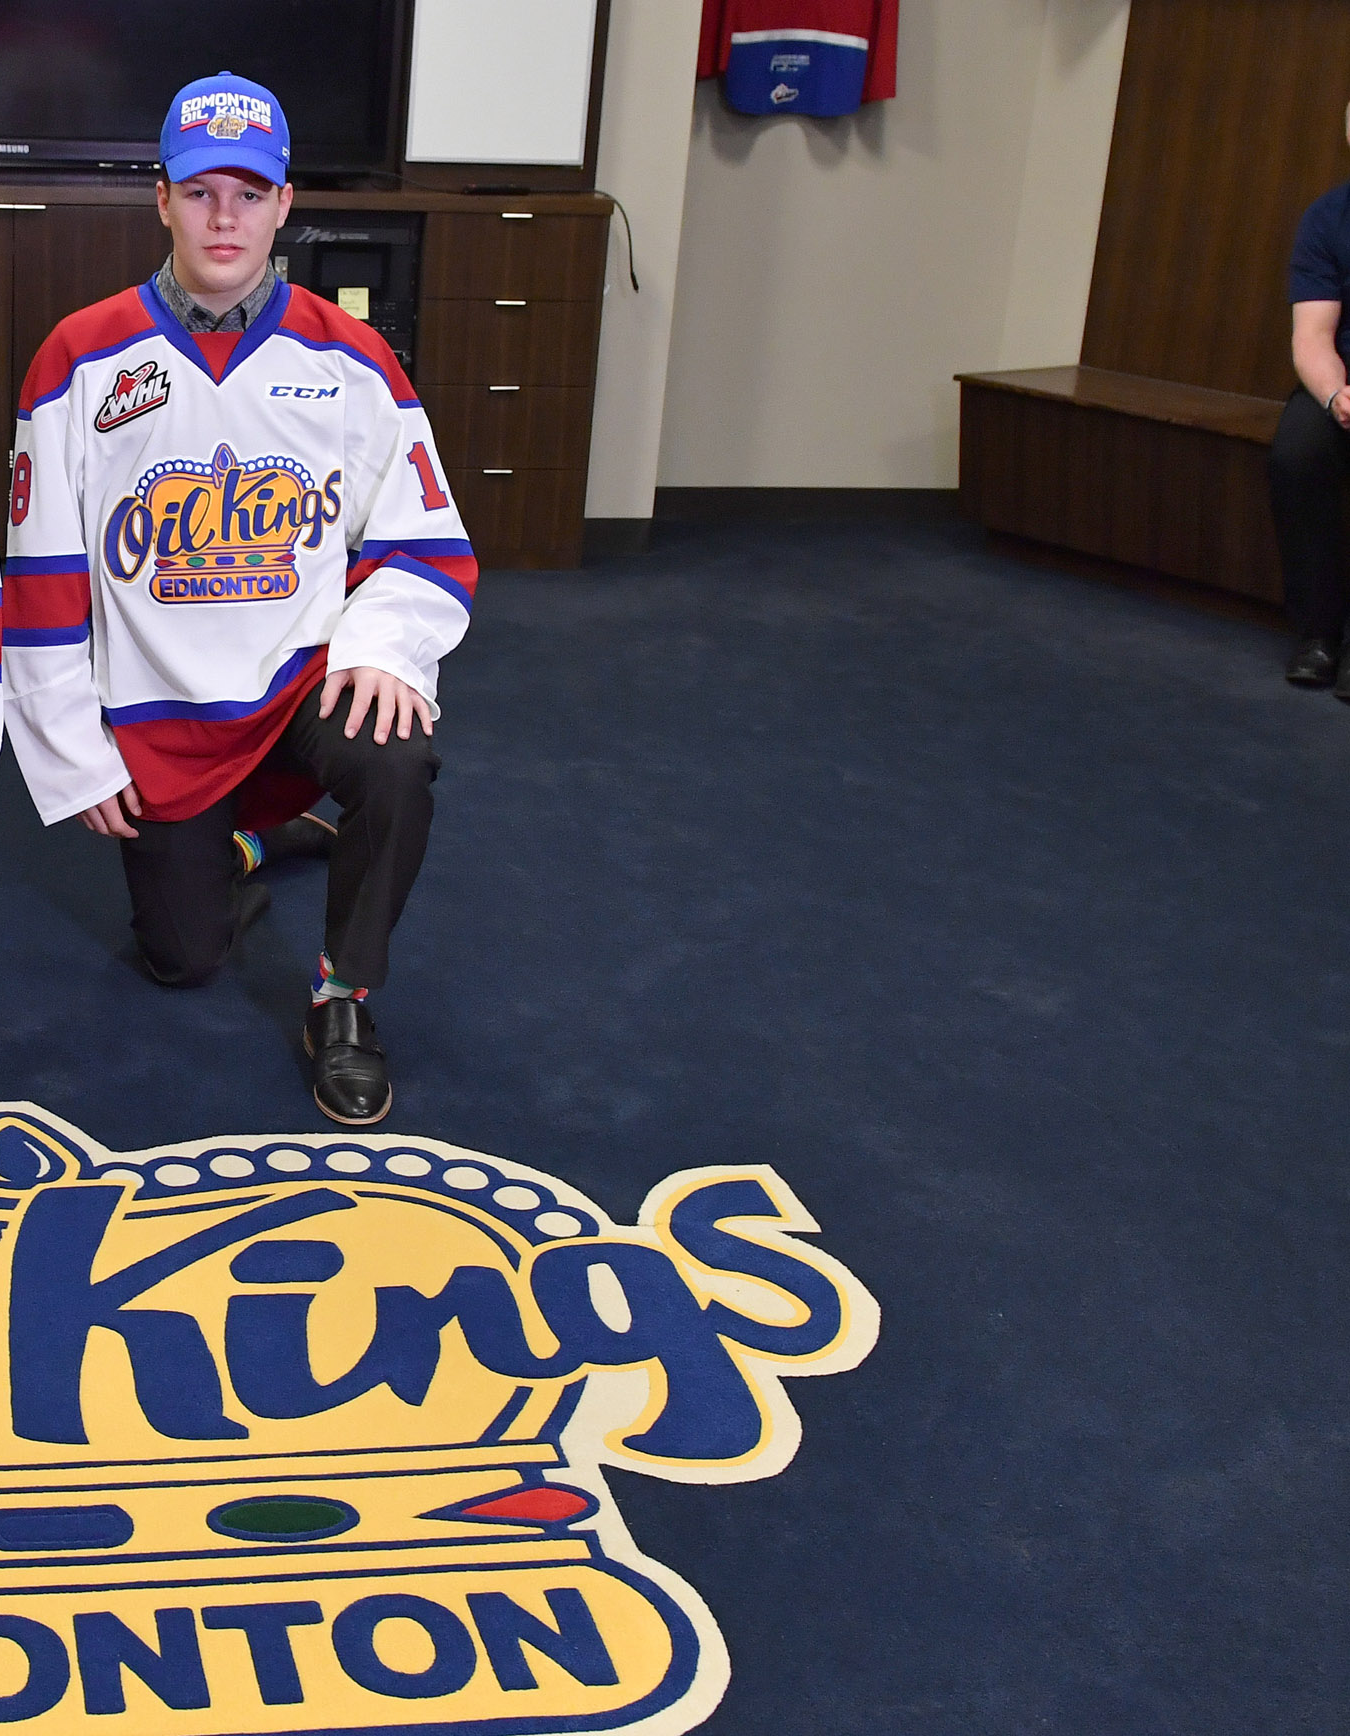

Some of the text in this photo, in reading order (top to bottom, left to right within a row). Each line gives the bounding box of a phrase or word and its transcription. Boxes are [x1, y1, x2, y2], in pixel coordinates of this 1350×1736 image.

[180, 109, 209, 125] OIL
[215, 106, 272, 128] KINGS
[181, 92, 271, 117] EDMONTON
[102, 373, 168, 421] WHL
[269, 385, 340, 399] CCM
[104, 469, 342, 581] Oil Kings
[159, 573, 290, 597] EDMONTON
[8, 1178, 841, 1460] Kings
